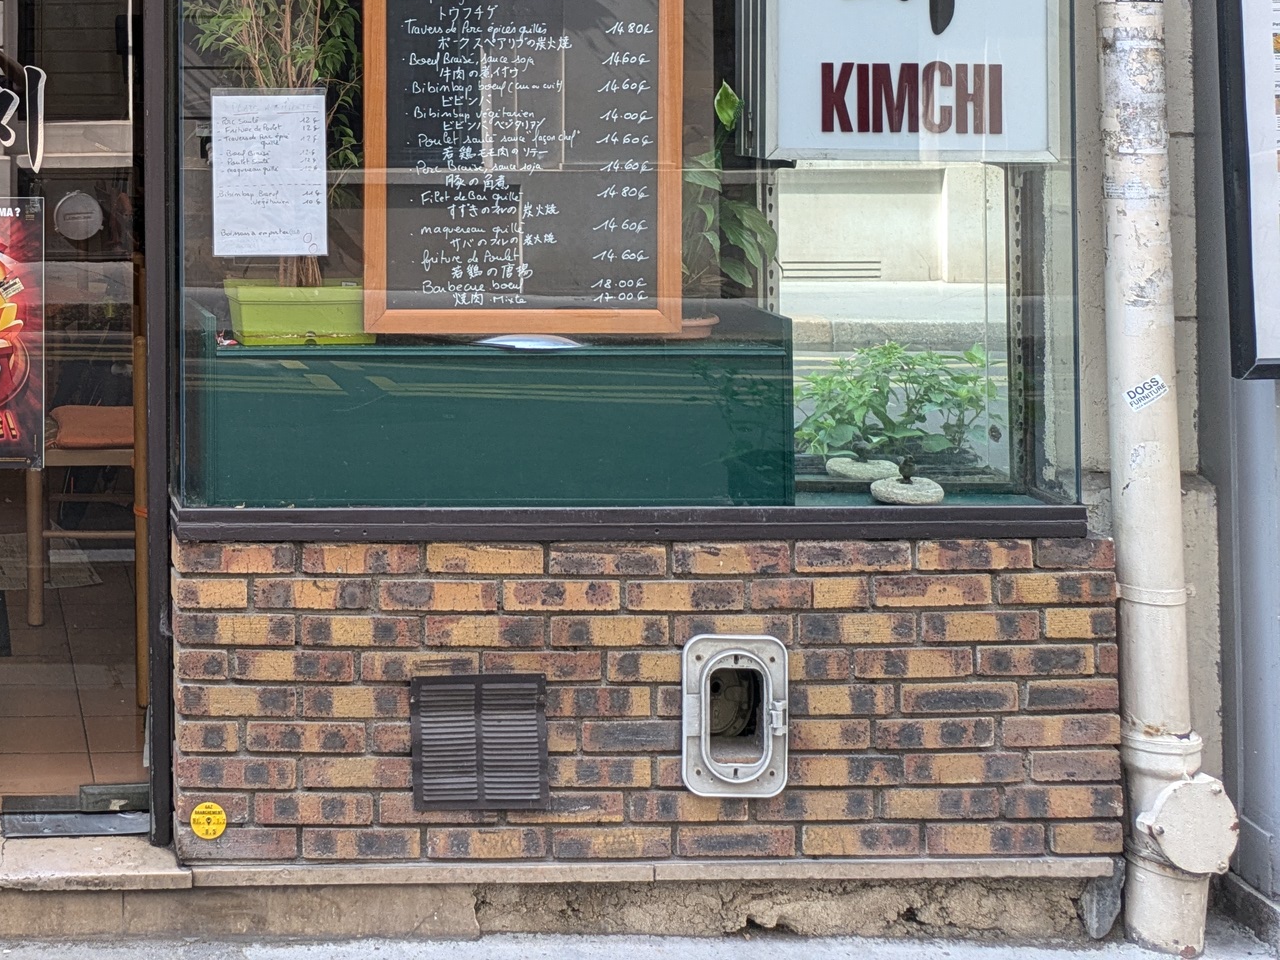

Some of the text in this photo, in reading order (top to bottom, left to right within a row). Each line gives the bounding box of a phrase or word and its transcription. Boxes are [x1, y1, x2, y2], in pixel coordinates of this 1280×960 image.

[821, 62, 1003, 135] KIMCHI
[14, 206, 21, 218] ?
[1126, 377, 1160, 400] DOGS
[1129, 382, 1167, 408] FURNITURE
